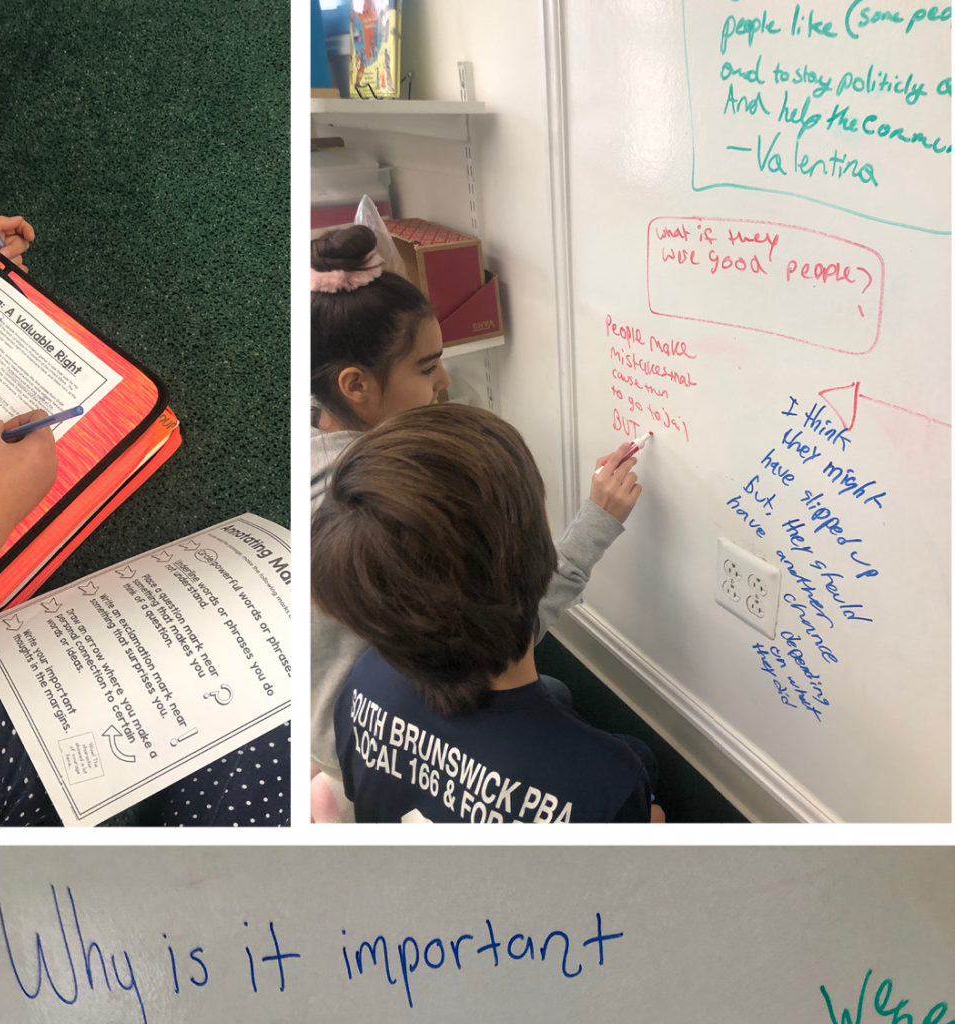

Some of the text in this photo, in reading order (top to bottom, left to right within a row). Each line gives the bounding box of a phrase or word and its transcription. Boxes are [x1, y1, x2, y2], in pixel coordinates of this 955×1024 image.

[719, 3, 839, 56] people like
[719, 54, 766, 86] and
[772, 62, 791, 85] to
[791, 64, 833, 99] stay
[723, 82, 859, 141] And help the
[696, 224, 717, 246] if
[726, 228, 780, 263] they
[708, 249, 768, 275] good
[4, 308, 15, 318] A
[15, 315, 55, 353] Valuable
[54, 350, 83, 375] Right
[780, 395, 853, 454] I think
[760, 447, 864, 547] have slipped
[781, 426, 887, 511] they might
[221, 524, 273, 559] Annotating
[781, 518, 815, 555] they
[809, 558, 875, 624] should
[173, 570, 209, 610] understand.
[211, 560, 262, 621] powerful words
[725, 494, 839, 665] have another chance
[118, 618, 173, 701] exclamation mark
[159, 591, 219, 677] question mark near
[169, 624, 206, 678] makes you
[198, 581, 274, 696] words phrases you do
[44, 665, 77, 715] important
[44, 689, 71, 734] margins.
[102, 661, 153, 749] where make
[125, 648, 170, 719] surprises you.
[350, 688, 575, 823] SOUTH BRUNSWICK PBA
[352, 726, 456, 811] LOCAL 166 &
[164, 933, 209, 995] is
[243, 920, 301, 993] it
[341, 912, 624, 1009] important
